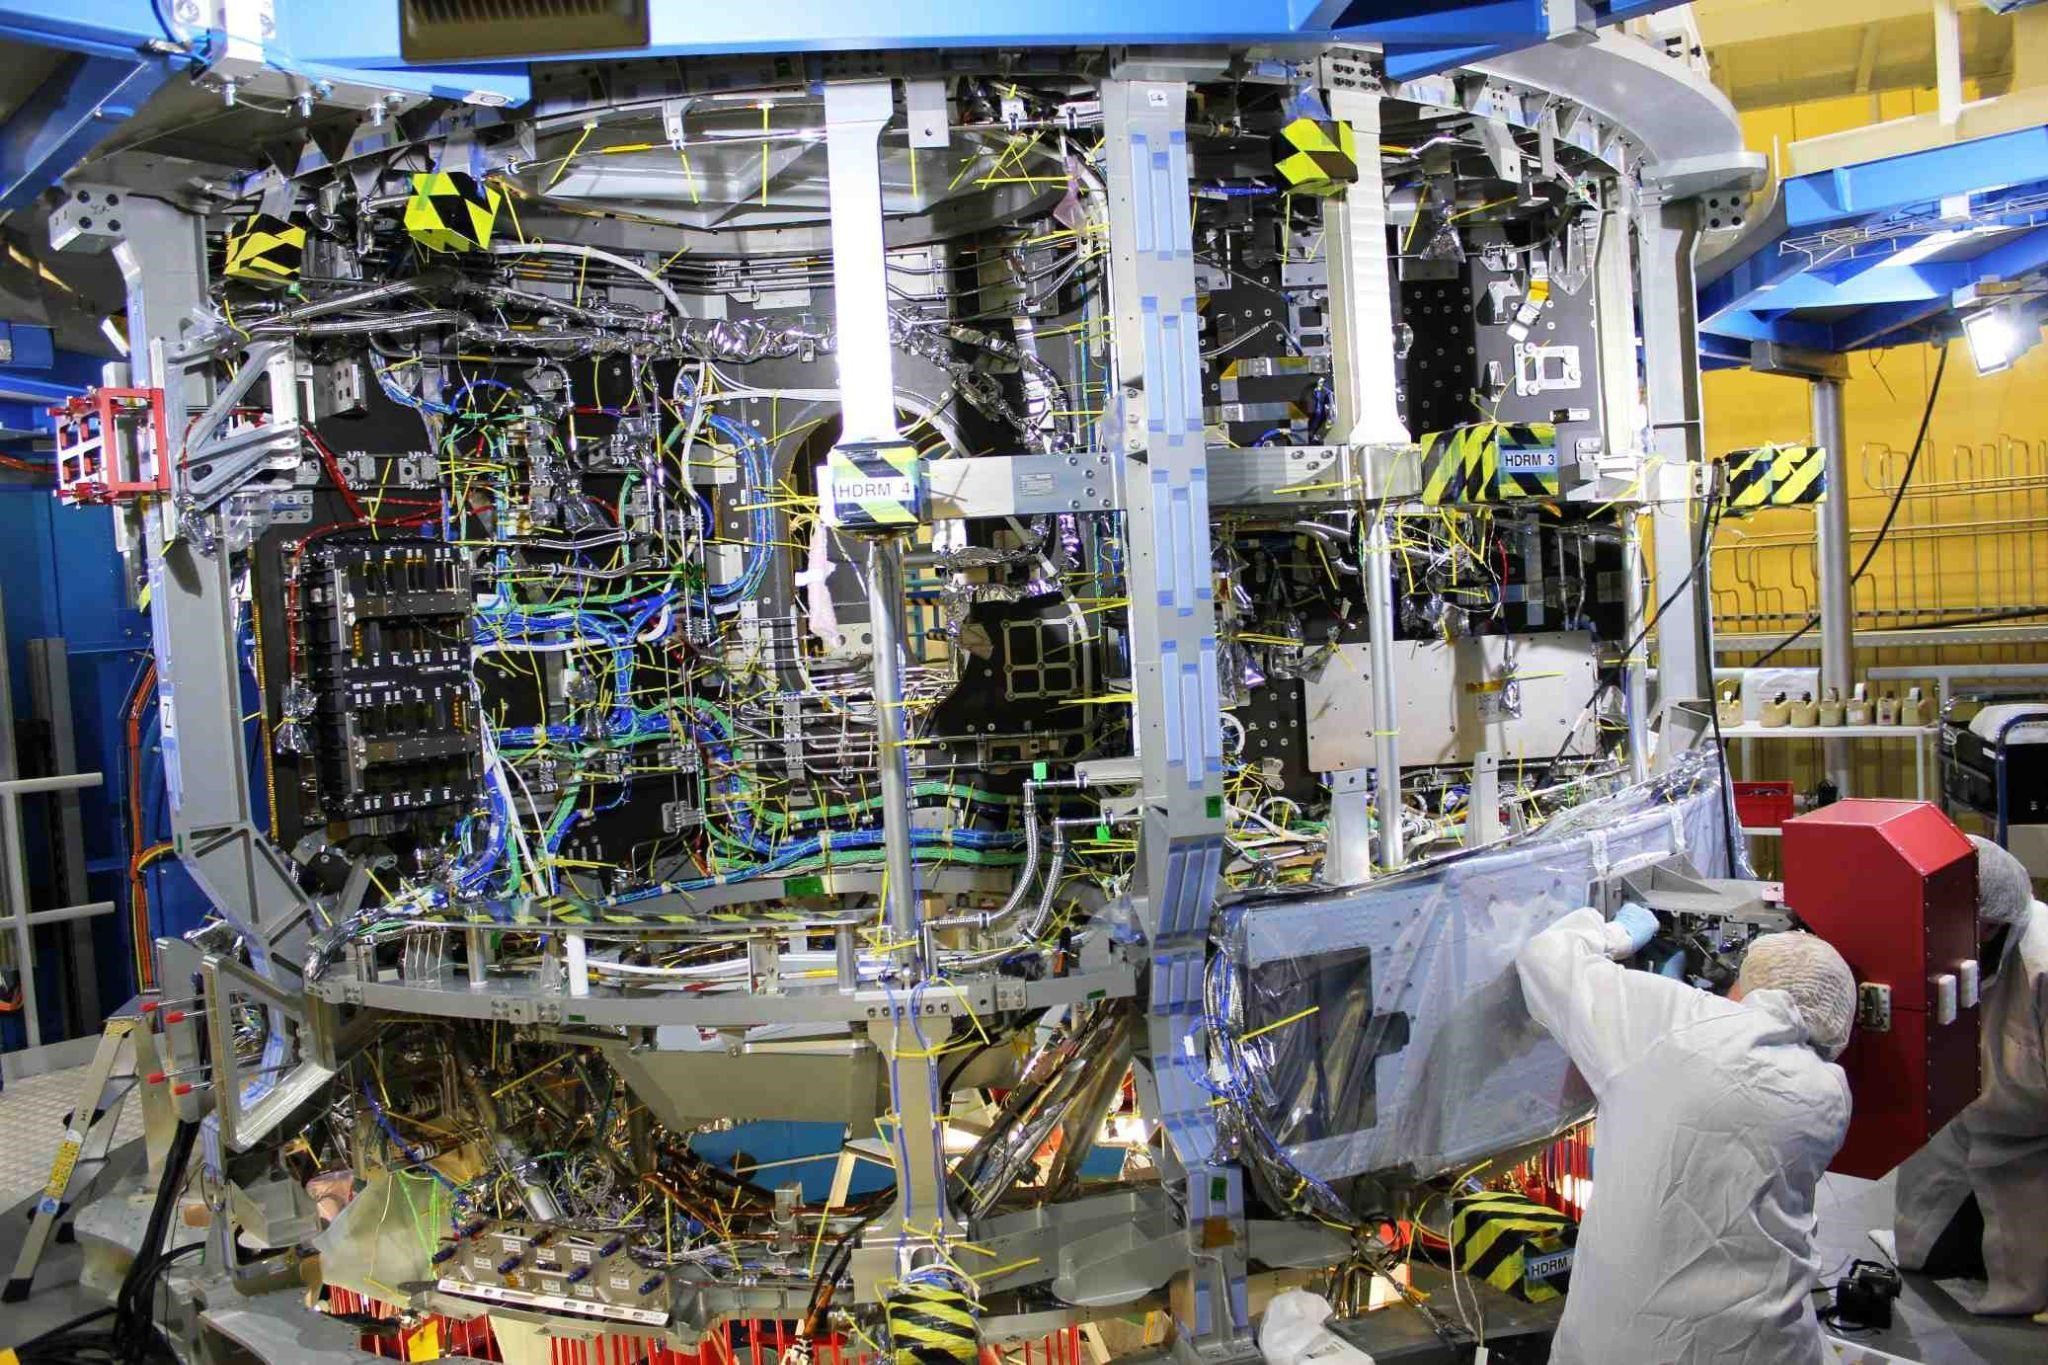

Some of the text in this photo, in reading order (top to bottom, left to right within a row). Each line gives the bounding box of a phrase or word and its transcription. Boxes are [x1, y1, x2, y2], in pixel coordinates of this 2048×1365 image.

[1505, 454, 1555, 466] HDRM 3
[839, 482, 910, 498] HDRM 4
[1531, 1256, 1567, 1276] HDRM
